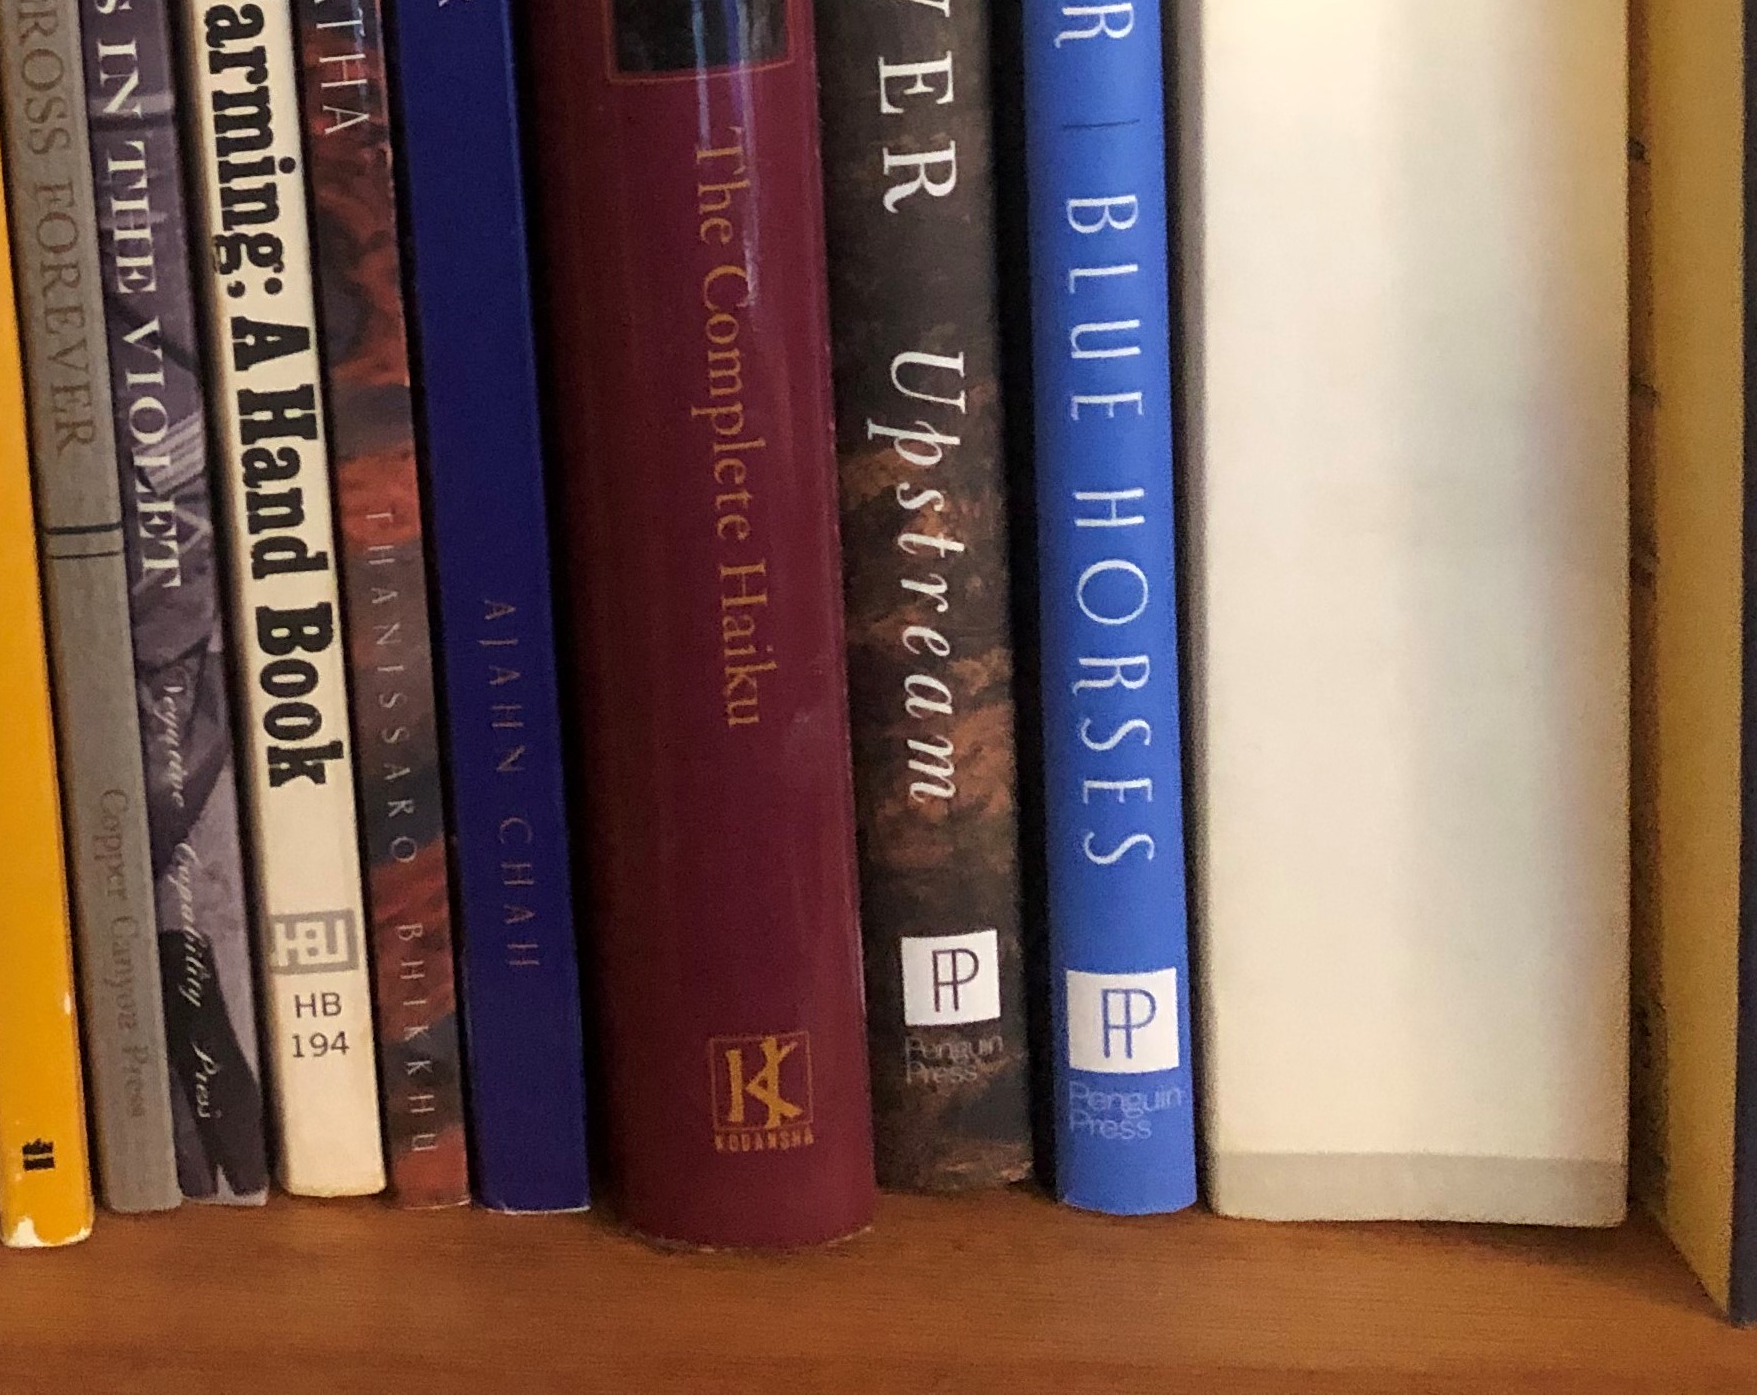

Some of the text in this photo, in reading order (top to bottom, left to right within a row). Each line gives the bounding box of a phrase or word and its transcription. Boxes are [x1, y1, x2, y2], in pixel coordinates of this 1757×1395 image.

[97, 39, 143, 118] IN
[107, 140, 158, 294] THE
[1066, 194, 1143, 421] BLUE
[34, 181, 96, 455] FOREVER
[231, 316, 311, 372] A
[124, 316, 181, 589] VIOLET
[237, 383, 329, 580] Hand
[692, 125, 777, 729] The Complete Haiku
[866, 351, 966, 804] Upstream
[256, 602, 344, 788] Book
[1072, 487, 1155, 865] HORSES
[92, 788, 129, 900] Copper
[365, 509, 438, 1152] THANISSARO BHIKKHU
[477, 600, 540, 966] AJAHN CHAH
[192, 1042, 221, 1118] Press
[291, 1030, 350, 1058] 194
[294, 992, 342, 1018] HB
[1069, 1080, 1181, 1119] Penguin
[1070, 1108, 1152, 1140] Press
